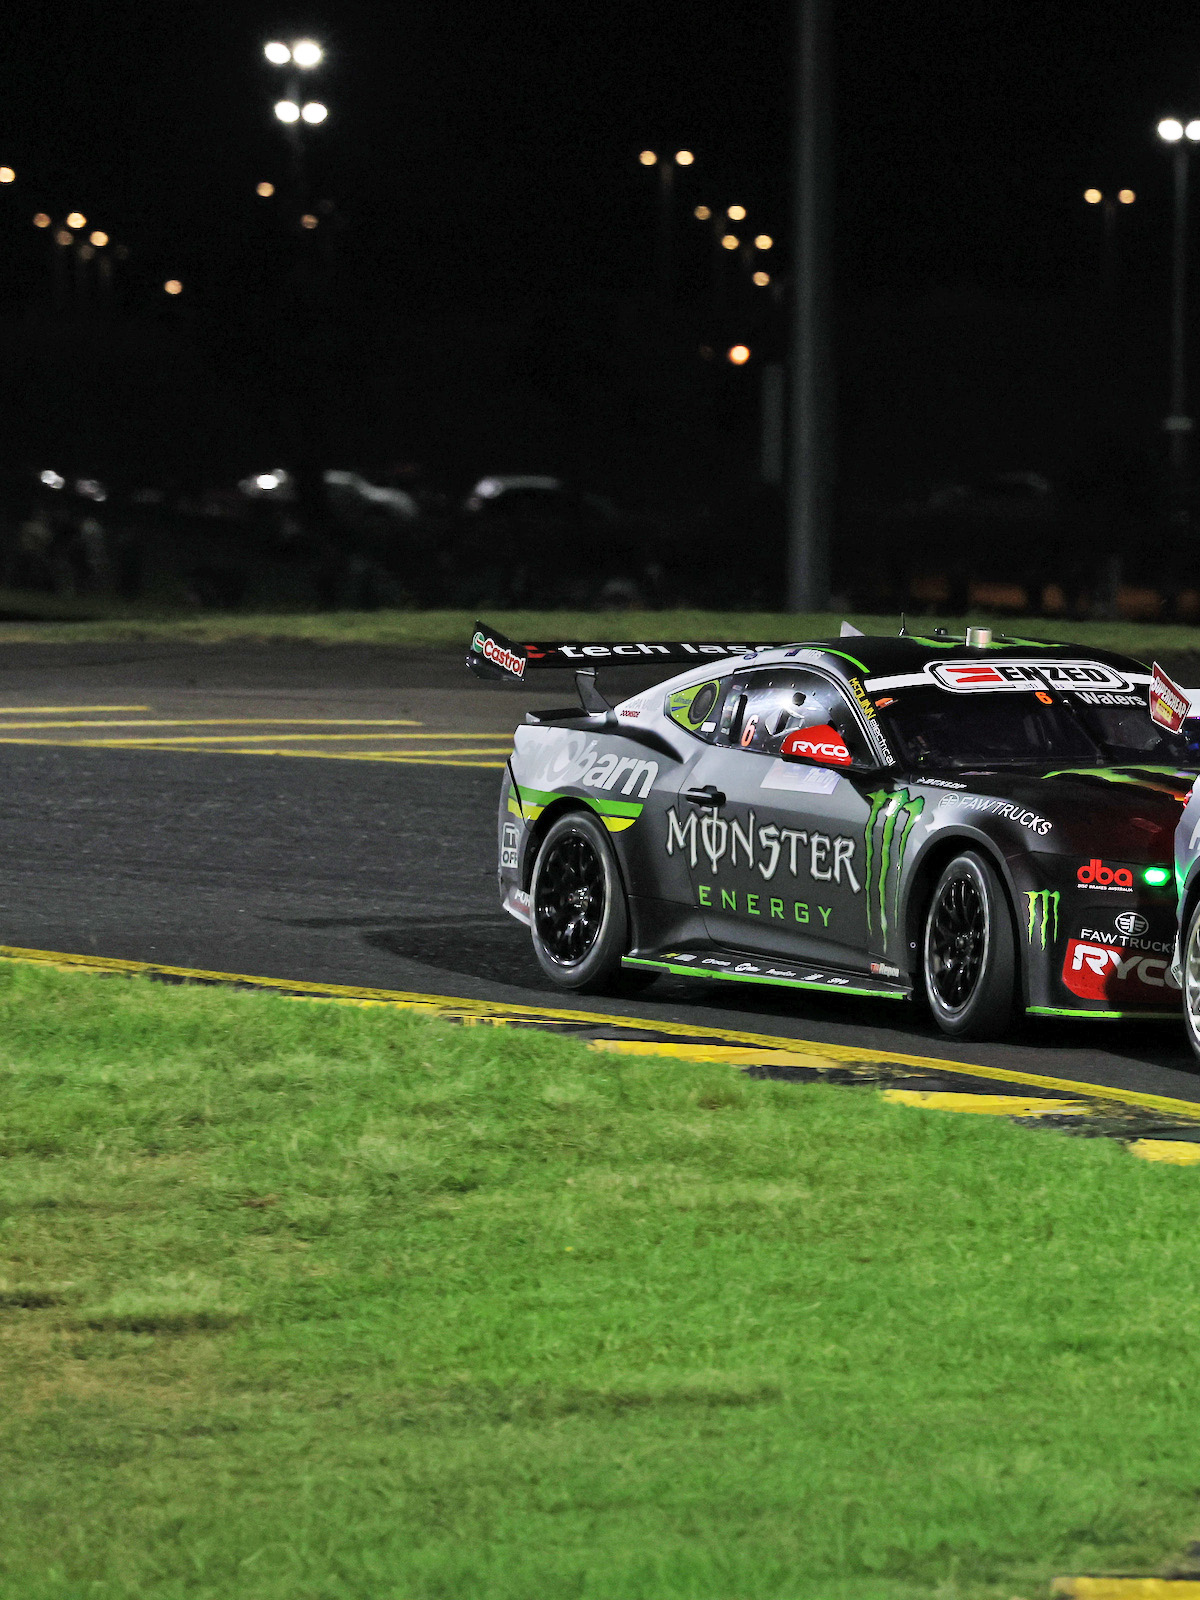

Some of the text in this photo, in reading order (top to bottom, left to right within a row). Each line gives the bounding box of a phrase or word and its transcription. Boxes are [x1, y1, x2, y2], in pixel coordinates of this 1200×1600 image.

[483, 638, 526, 677] Castrol
[558, 643, 671, 658] tech
[995, 666, 1111, 683] ENZED
[1035, 691, 1148, 706] 6 Waters
[1150, 676, 1187, 718] SUPERCHEAP
[741, 715, 759, 747] 6
[869, 719, 897, 767] electrical
[792, 740, 850, 758] RYCO
[957, 796, 1053, 836] FAW TRUCKS
[666, 807, 862, 893] MONSTER
[1077, 859, 1133, 887] dba
[698, 884, 834, 928] ENERGY
[1080, 928, 1118, 944] FAW
